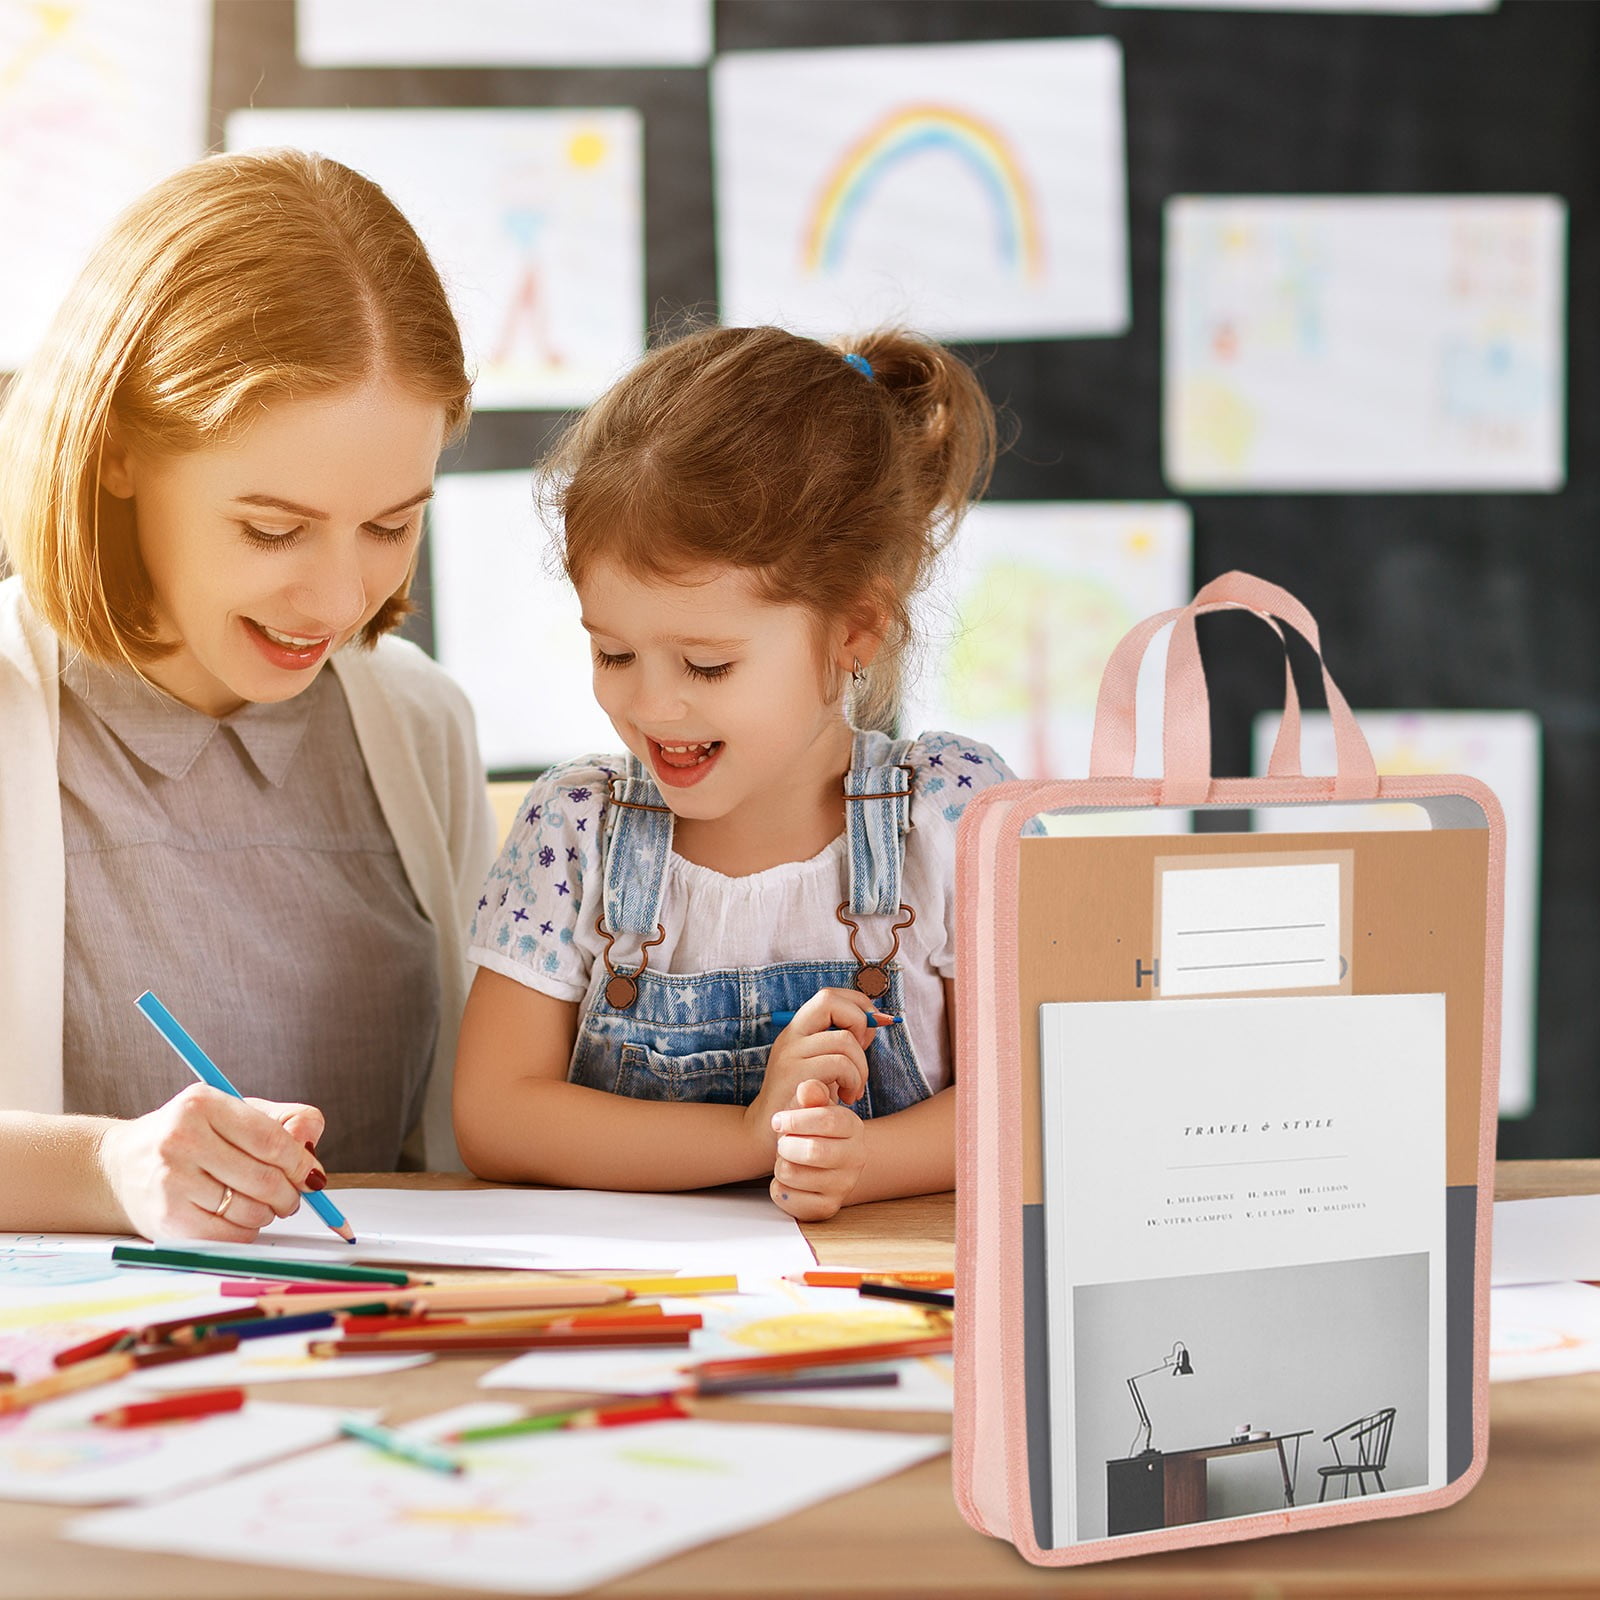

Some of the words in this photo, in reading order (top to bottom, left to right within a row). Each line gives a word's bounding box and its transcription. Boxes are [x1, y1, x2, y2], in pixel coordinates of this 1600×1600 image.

[1184, 1124, 1250, 1136] TRAVEL
[1261, 1122, 1271, 1132] &
[1282, 1118, 1335, 1131] STYLE
[1177, 1193, 1235, 1204] MELBOURNE
[1263, 1189, 1287, 1198] BATH
[1317, 1184, 1349, 1193] LISBON
[1163, 1216, 1193, 1225] VITRA
[1195, 1213, 1234, 1223] CAMPUS
[1257, 1209, 1268, 1218] LE
[1271, 1207, 1296, 1217] LABO
[1323, 1202, 1368, 1212] MALDIVES
